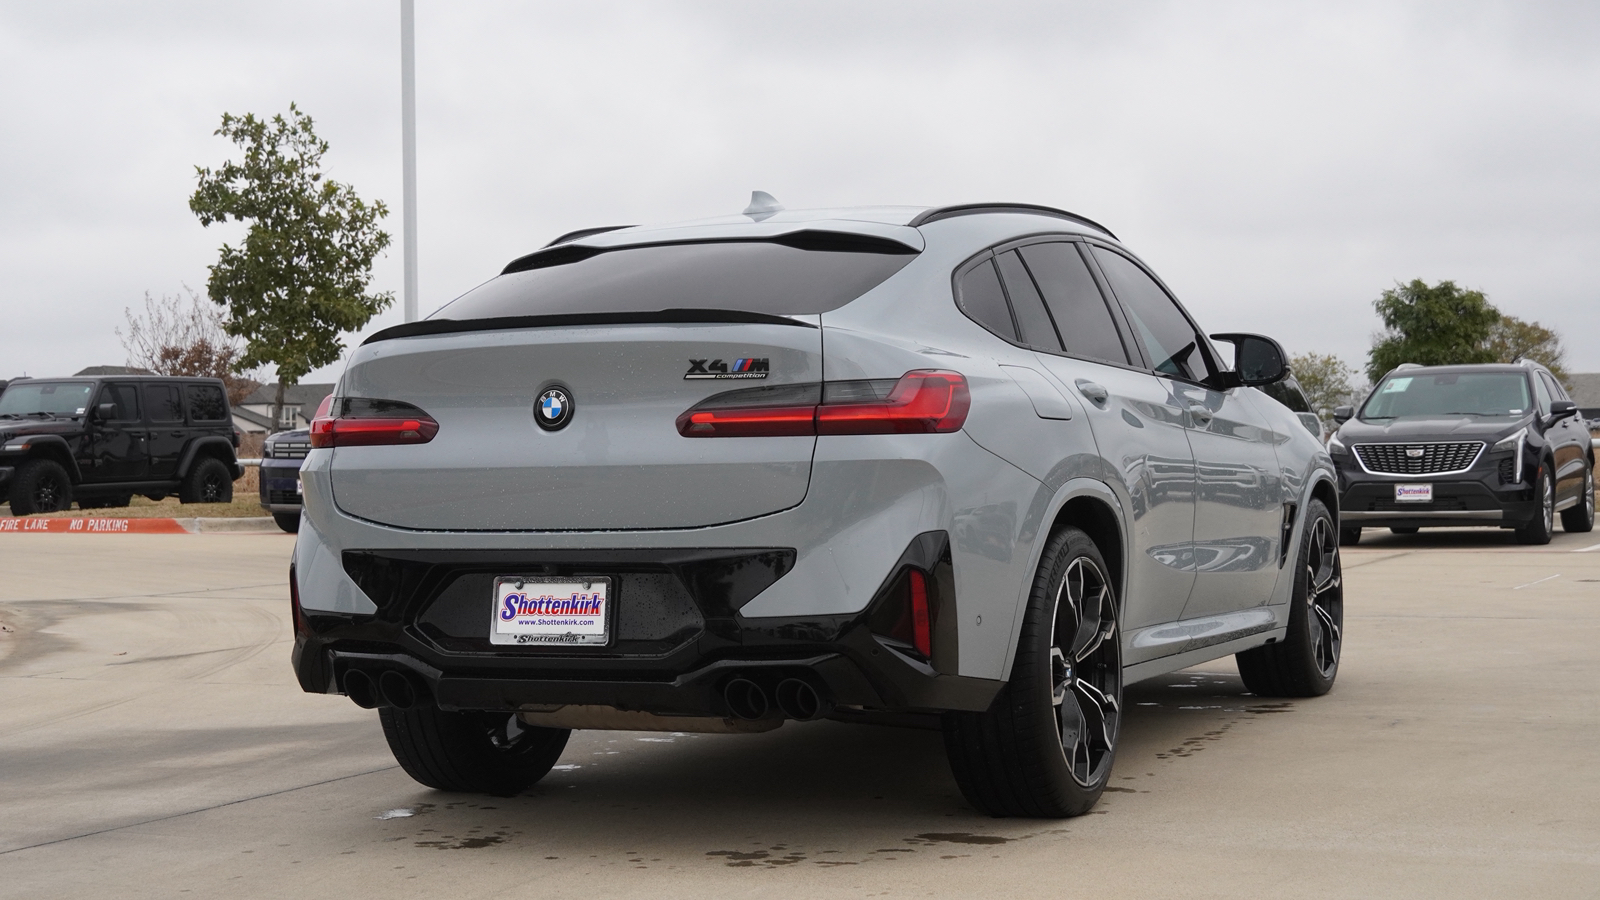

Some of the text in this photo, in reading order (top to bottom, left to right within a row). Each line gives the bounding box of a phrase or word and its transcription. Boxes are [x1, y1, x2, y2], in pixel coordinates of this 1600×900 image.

[687, 358, 728, 373] X4
[540, 391, 566, 403] BMW
[0, 519, 129, 531] FIRE LANE NO PARKING
[500, 593, 604, 621] Shottenkirk
[517, 632, 579, 644] Shottenkirk
